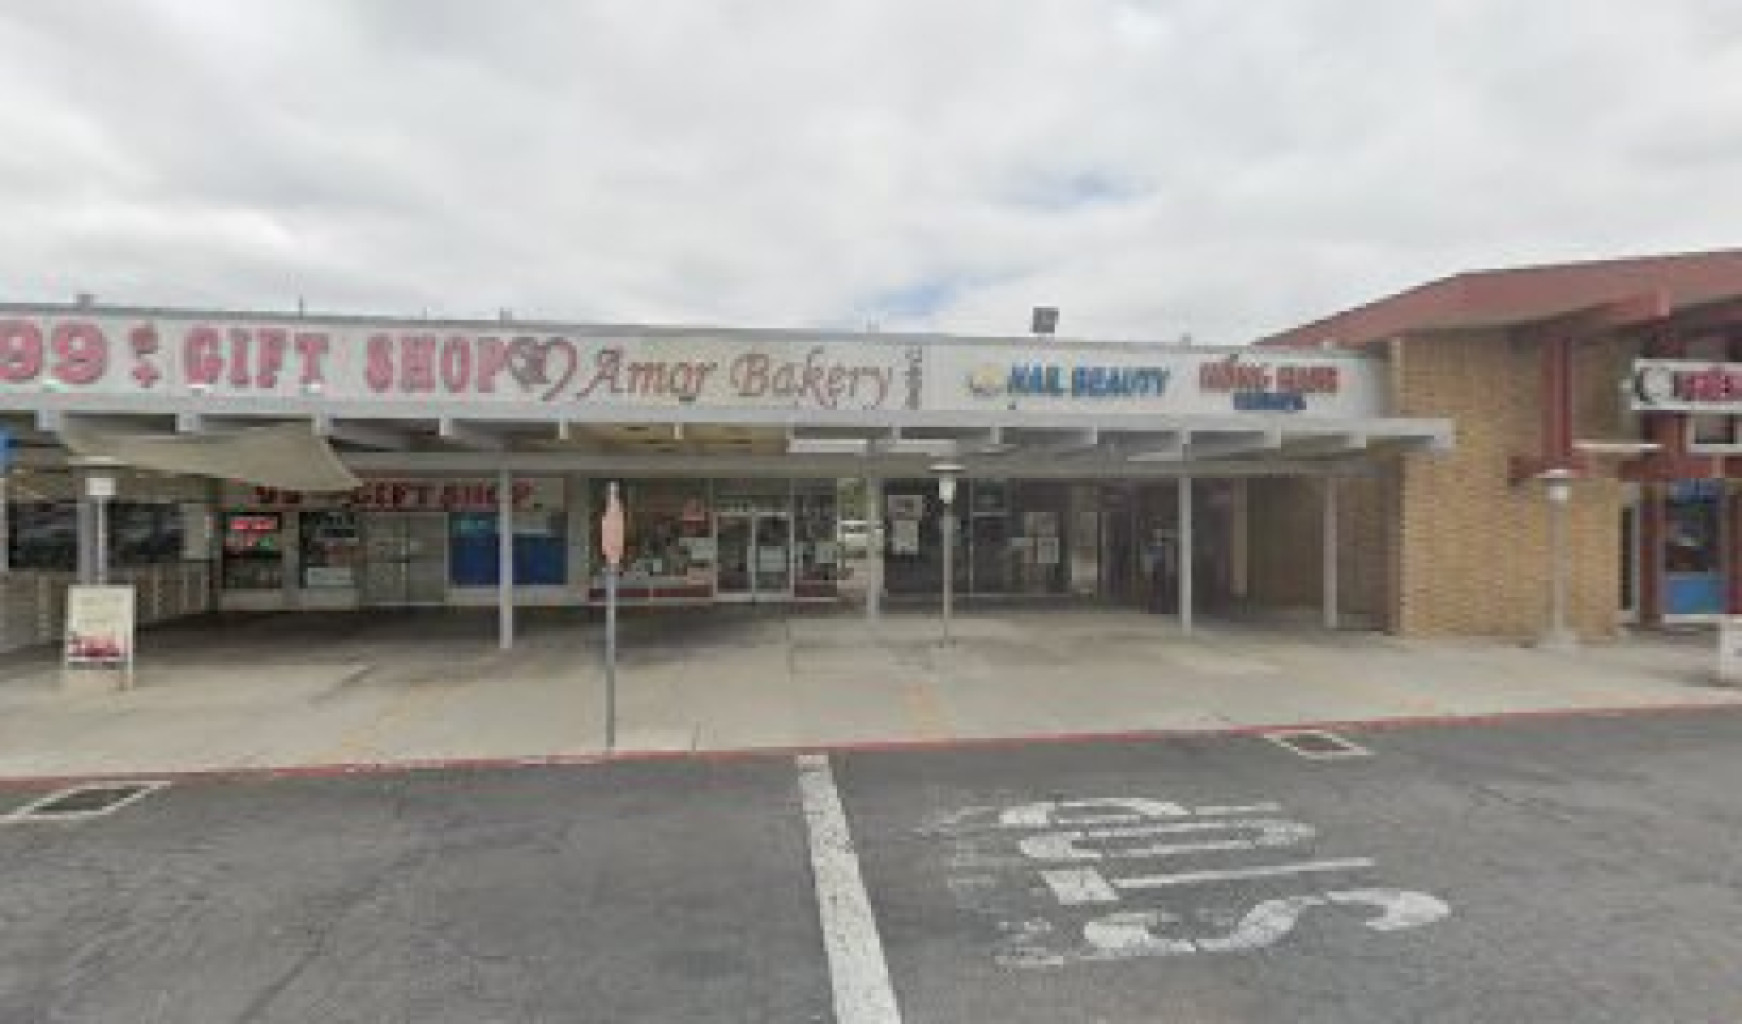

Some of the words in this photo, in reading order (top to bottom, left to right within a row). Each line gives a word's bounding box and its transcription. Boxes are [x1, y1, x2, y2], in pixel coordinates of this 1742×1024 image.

[183, 326, 329, 389] GIFT
[363, 333, 509, 394] SHOP
[575, 347, 718, 402] Amor
[730, 346, 893, 410] Bakery
[1007, 362, 1066, 396] NAIL
[1072, 364, 1169, 396] BEAUTY
[352, 483, 433, 510] GIFT
[998, 796, 1452, 952] STOP
